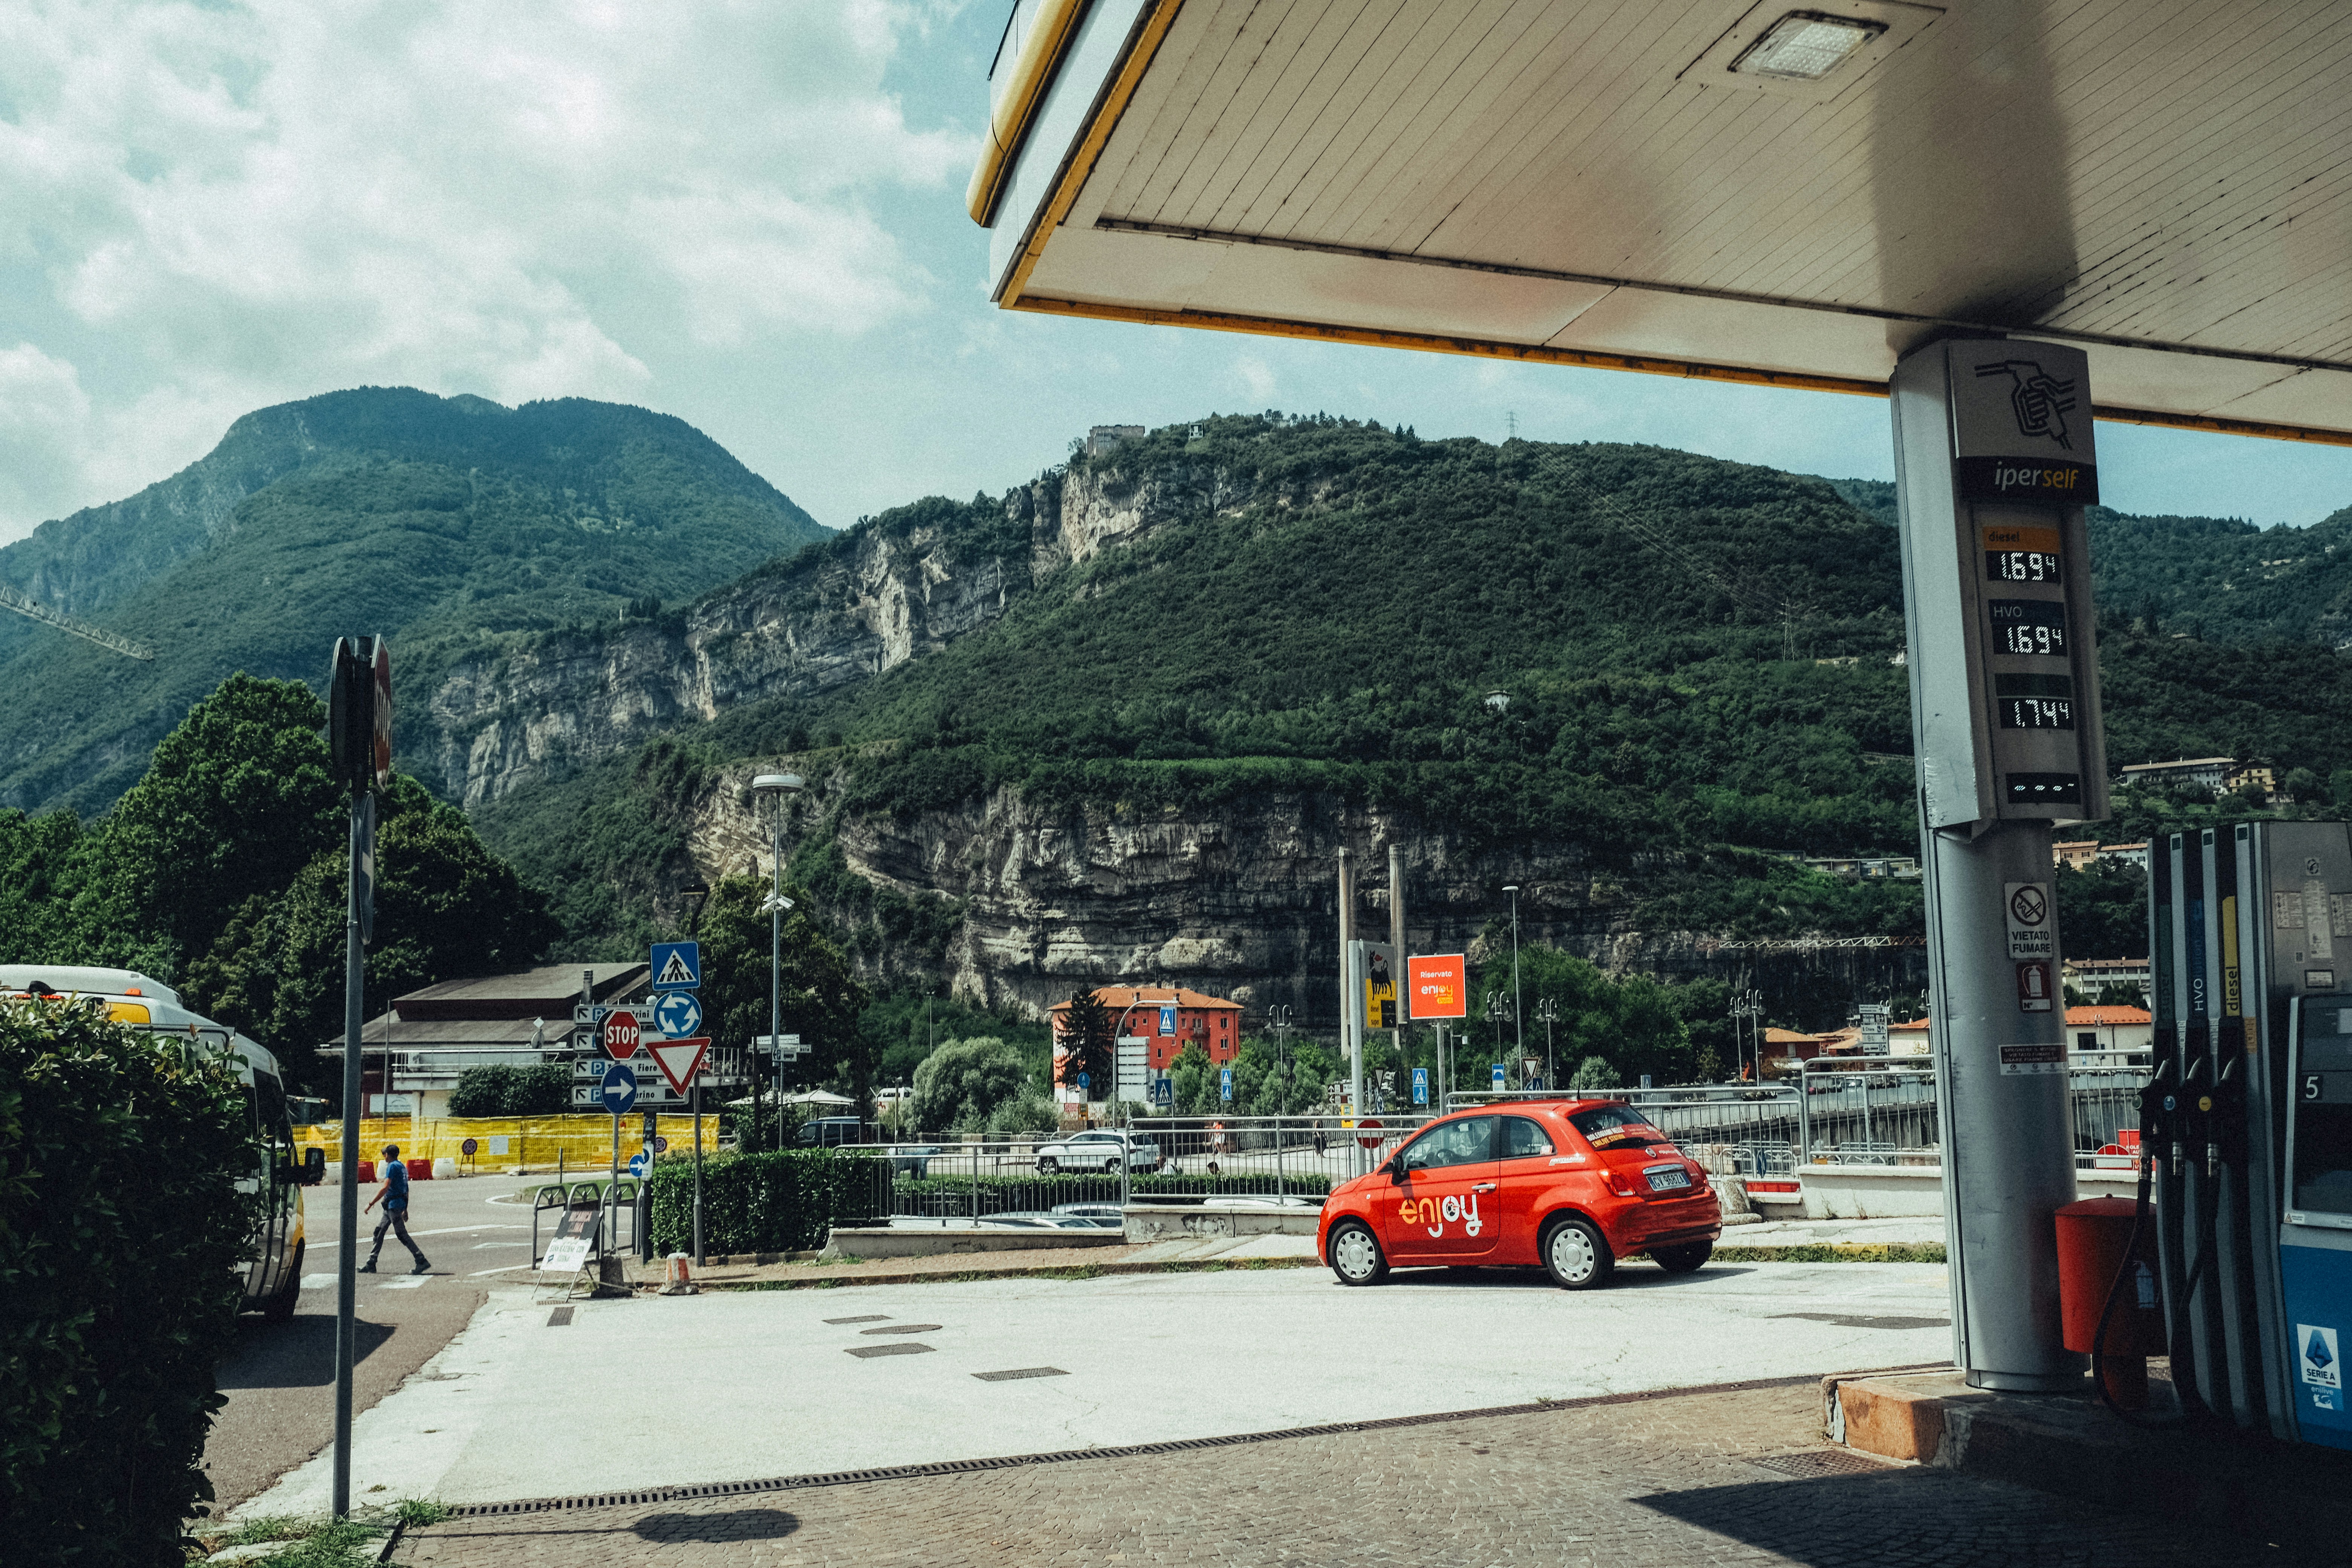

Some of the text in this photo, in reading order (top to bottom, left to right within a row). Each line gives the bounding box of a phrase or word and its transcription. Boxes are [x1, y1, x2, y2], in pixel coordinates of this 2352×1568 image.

[1995, 461, 2078, 490] iperself
[1989, 531, 2020, 542] diesel
[1994, 606, 2022, 617] HVO
[2012, 931, 2049, 940] VIETATO
[2013, 943, 2050, 953] FUMARE
[1421, 985, 1453, 997] enjoy
[2226, 966, 2239, 1011] diesel
[1371, 1019, 1380, 1027] super
[607, 1026, 638, 1044] STOP
[2306, 1076, 2318, 1099] 5
[1663, 1173, 1685, 1185] 968ZA
[1398, 1194, 1483, 1238] enjoy
[2307, 1369, 2328, 1379] SERIE
[2311, 1386, 2334, 1395] enilive
